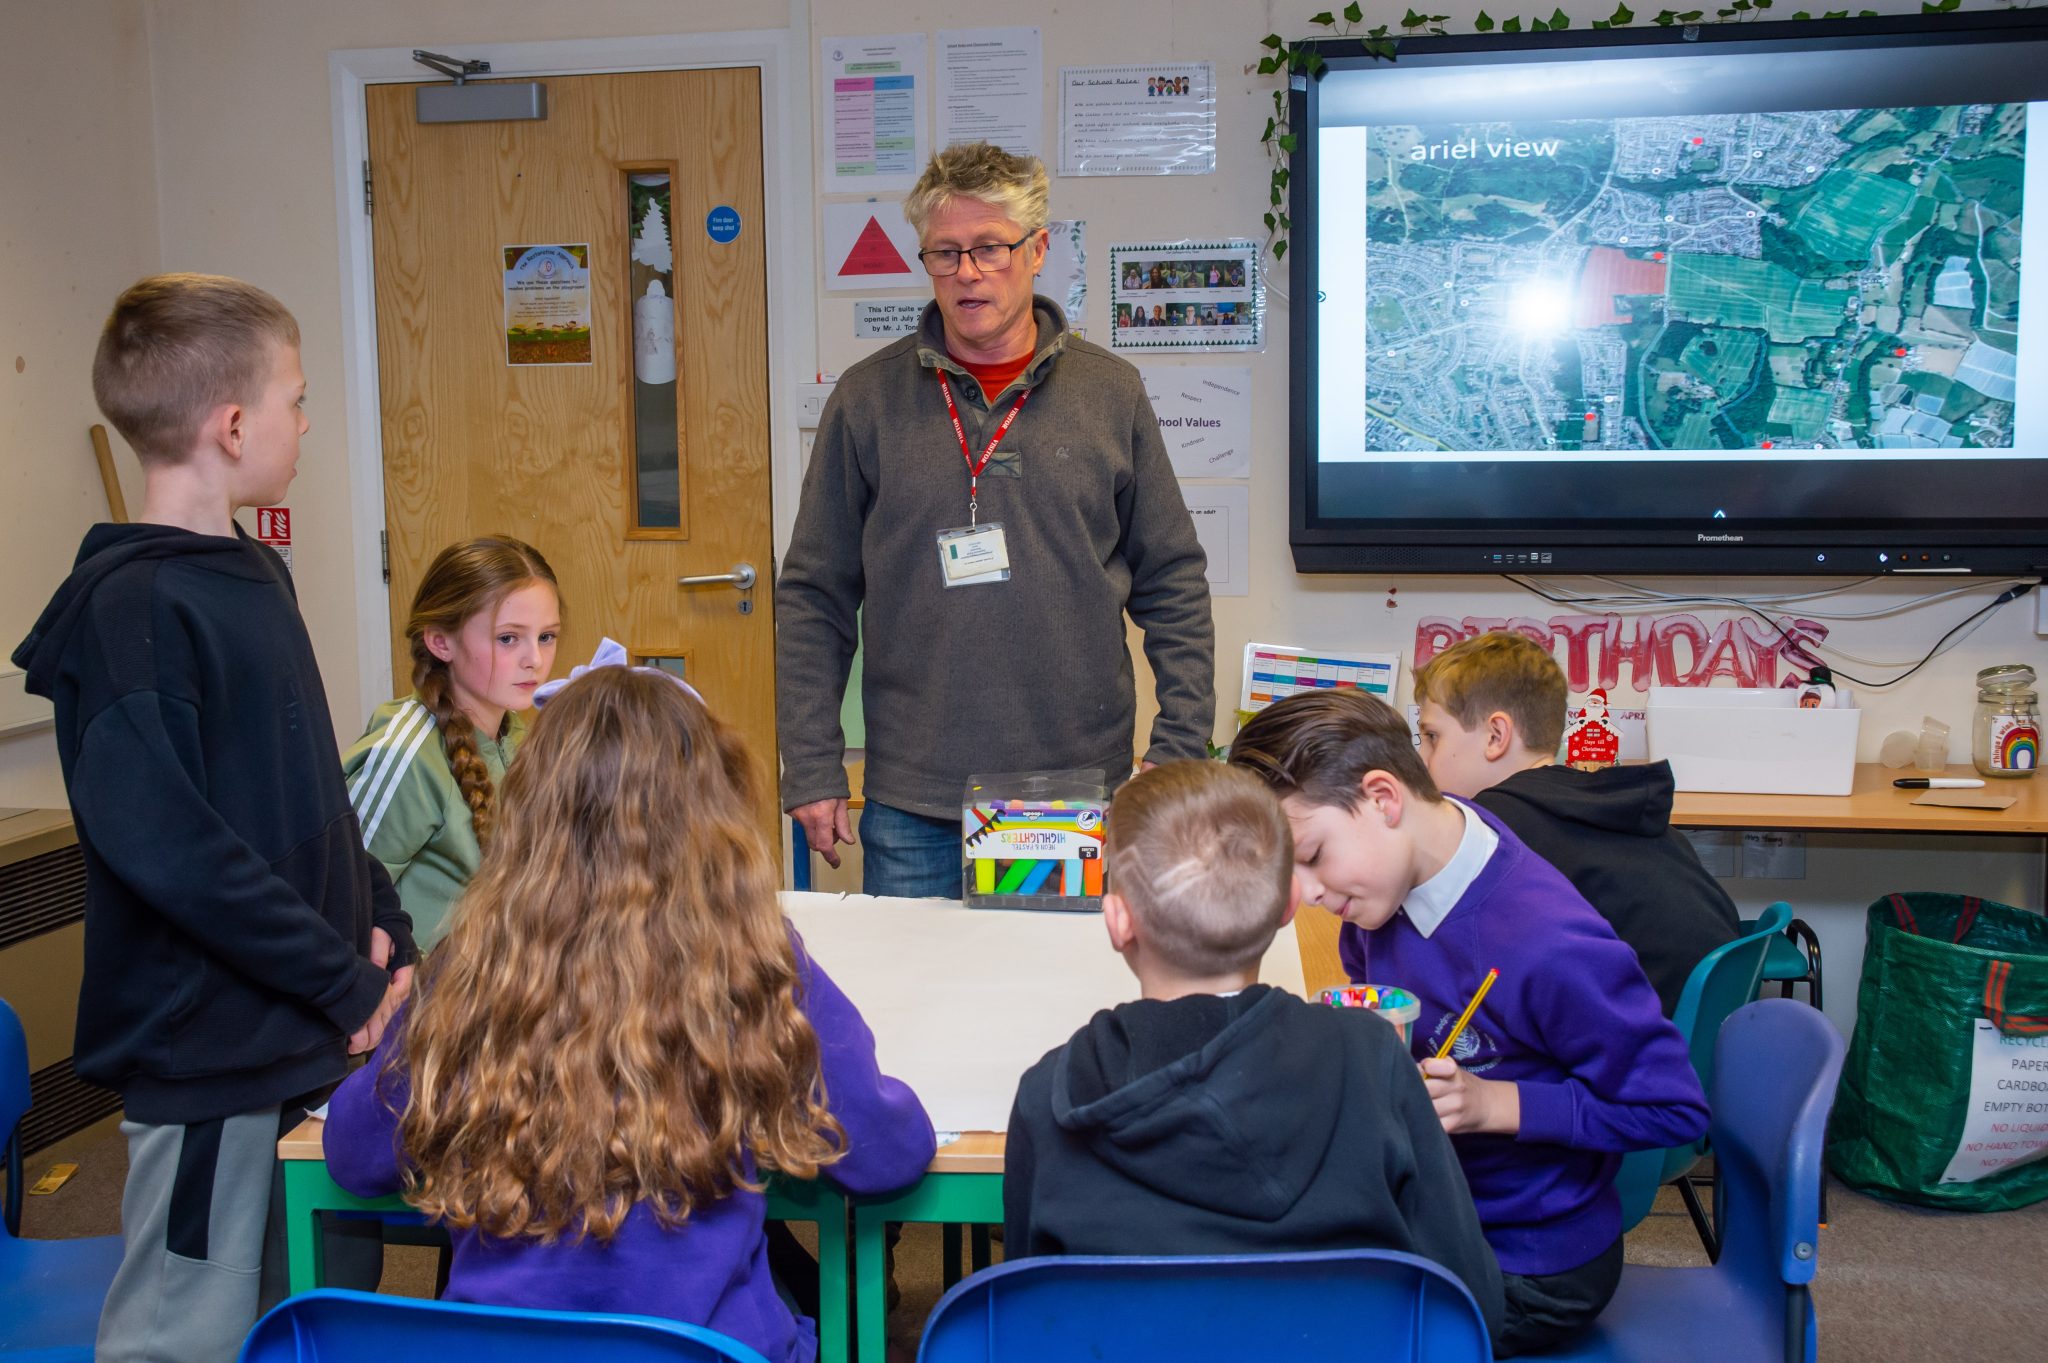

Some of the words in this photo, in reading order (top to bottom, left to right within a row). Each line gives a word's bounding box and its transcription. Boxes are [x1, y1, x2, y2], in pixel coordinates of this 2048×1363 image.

[1410, 137, 1476, 161] ariel
[1486, 137, 1559, 158] view
[1202, 379, 1241, 396] Independence
[941, 382, 954, 408] VISITOR
[1180, 392, 1202, 403] Respect
[1001, 407, 1020, 430] VISITOR
[1158, 417, 1182, 427] hool
[1185, 417, 1221, 428] Values
[952, 417, 965, 445] VISITOR
[1181, 437, 1205, 449] Kindness
[981, 438, 999, 464] VISITOR
[1208, 449, 1234, 464] Challenge
[1697, 533, 1744, 542] Promethean
[1620, 711, 1646, 720] APRI
[1000, 832, 1066, 843] HIGHLIGHTERS
[2012, 1058, 2048, 1072] PAPER
[1997, 1079, 2048, 1092] CARDBO
[1983, 1101, 2023, 1113] EMPTY
[1991, 1123, 2009, 1133] NO
[1966, 1142, 1983, 1151] NO
